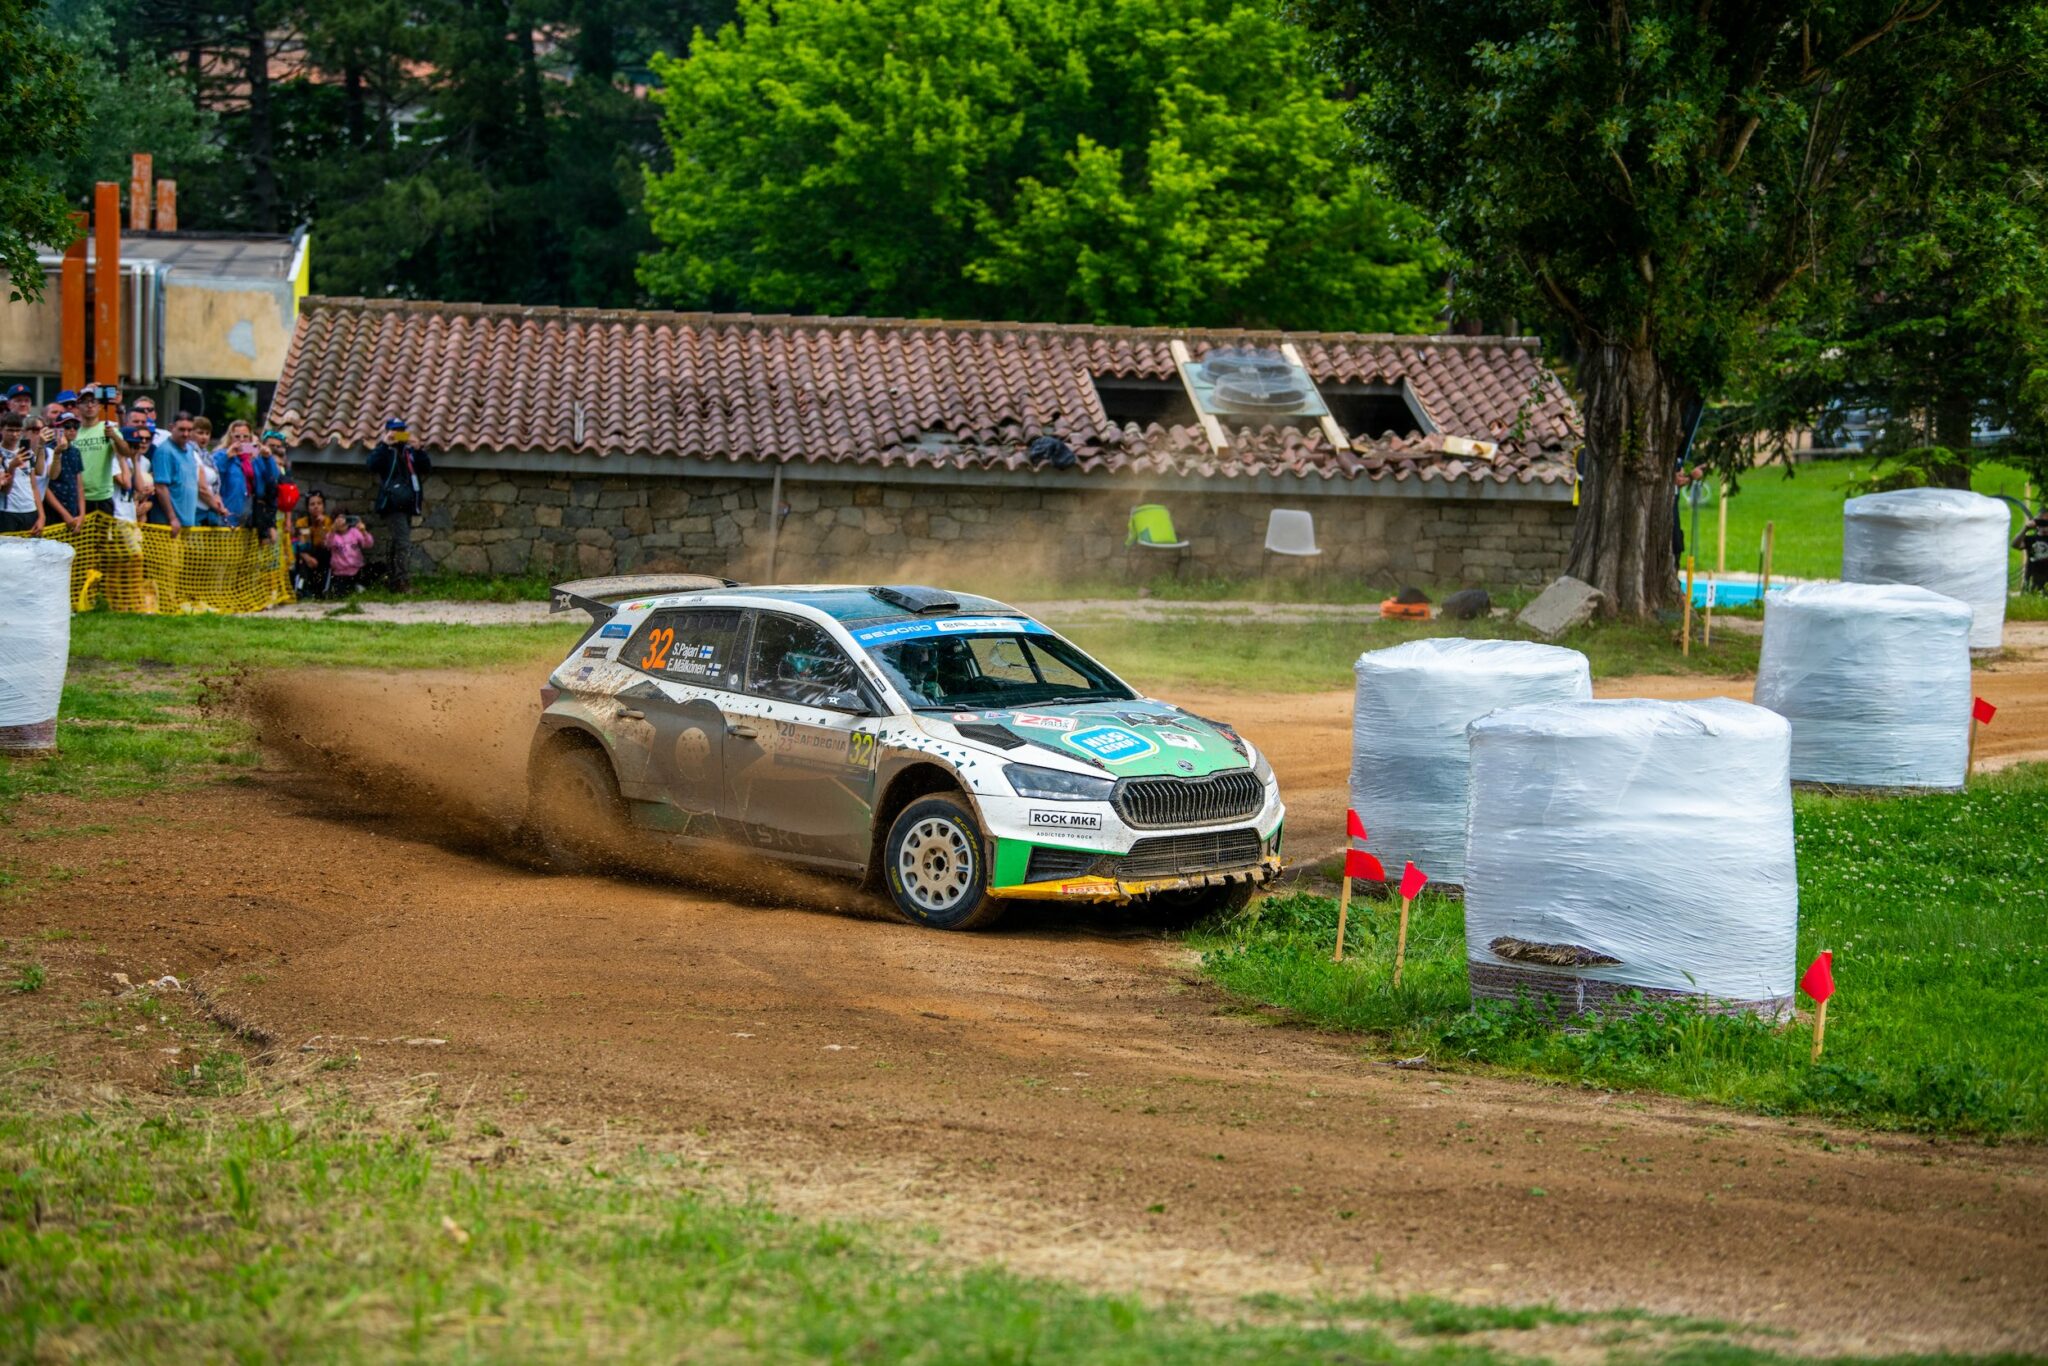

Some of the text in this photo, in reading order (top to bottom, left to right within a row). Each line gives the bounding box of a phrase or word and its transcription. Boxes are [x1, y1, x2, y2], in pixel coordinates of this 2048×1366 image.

[860, 624, 933, 641] BEYOND
[642, 627, 674, 670] 32
[848, 732, 873, 767] 32
[1034, 813, 1097, 826] ROCK MKR
